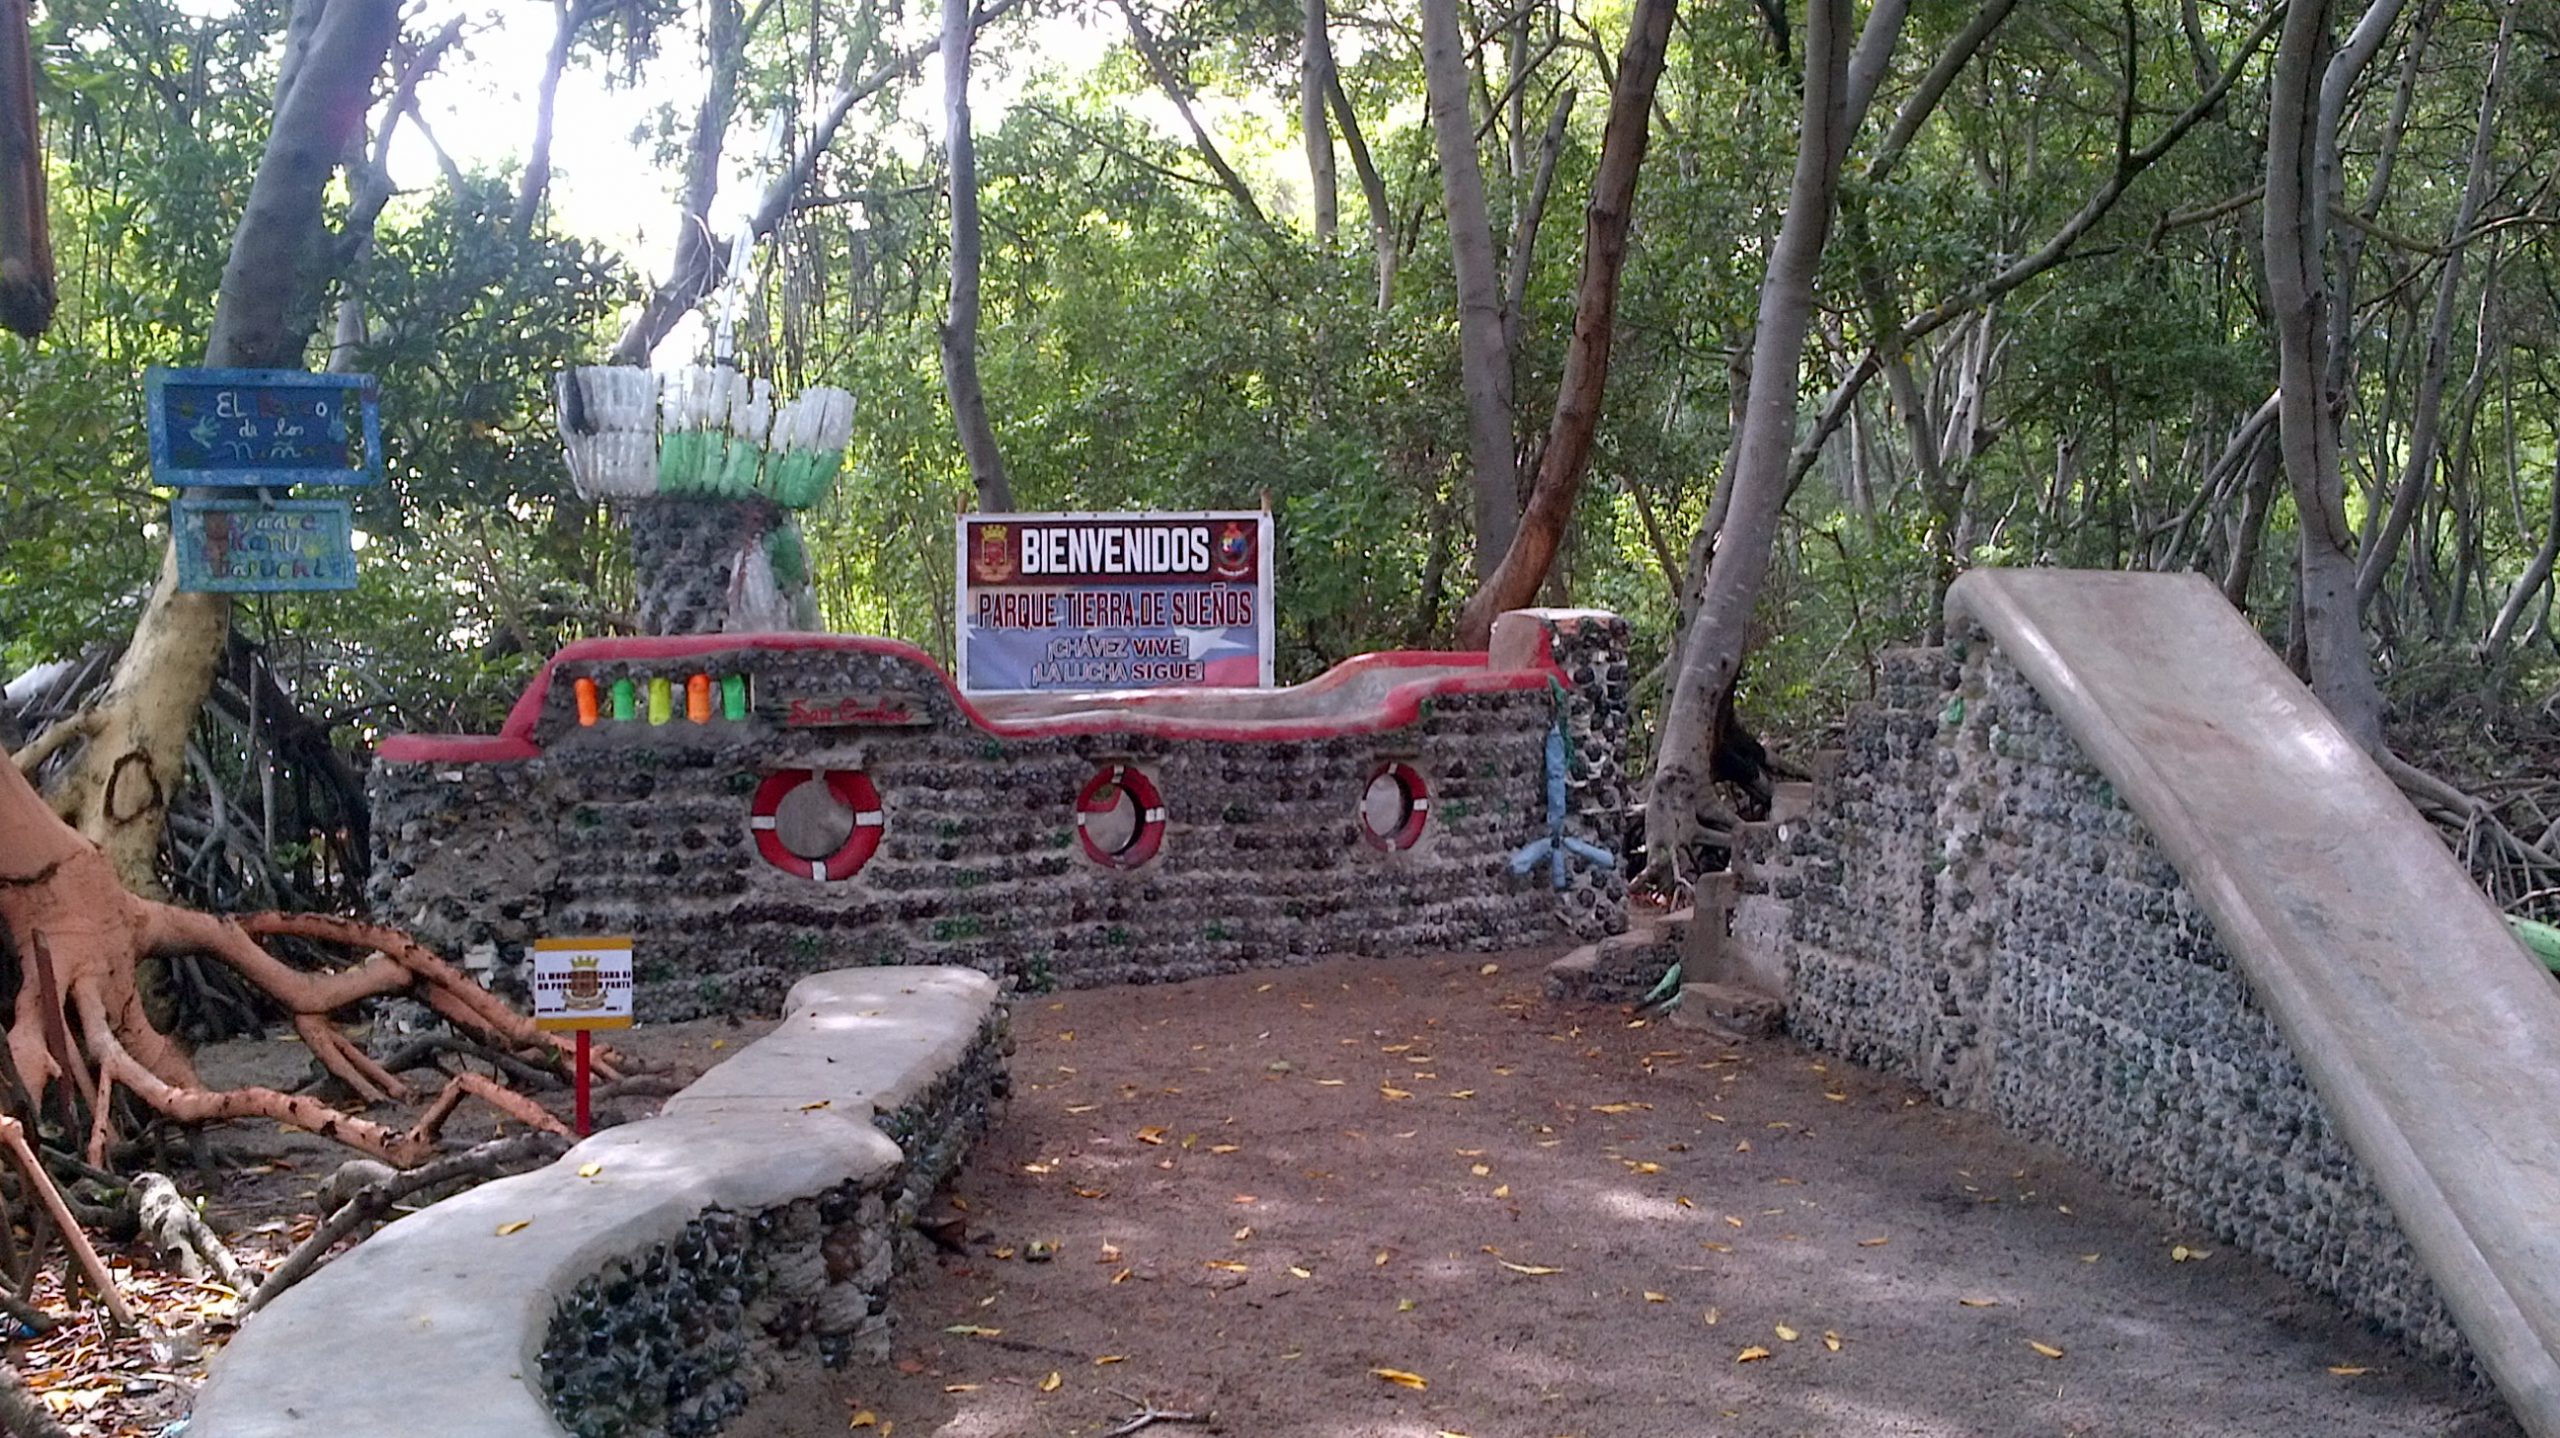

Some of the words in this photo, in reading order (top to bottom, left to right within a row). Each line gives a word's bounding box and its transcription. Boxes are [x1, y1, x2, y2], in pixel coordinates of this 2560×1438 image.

[1021, 526, 1210, 574] BIENVENIDOS
[979, 592, 1058, 629] PARQUE
[1064, 591, 1135, 628] TIERRA
[1140, 591, 1166, 627] DE
[1172, 581, 1252, 626] SUEÑOS
[1132, 636, 1188, 658] VIVE!
[1063, 662, 1128, 684] LUCHA
[1132, 662, 1204, 682] SIGUE!
[788, 697, 833, 727] San
